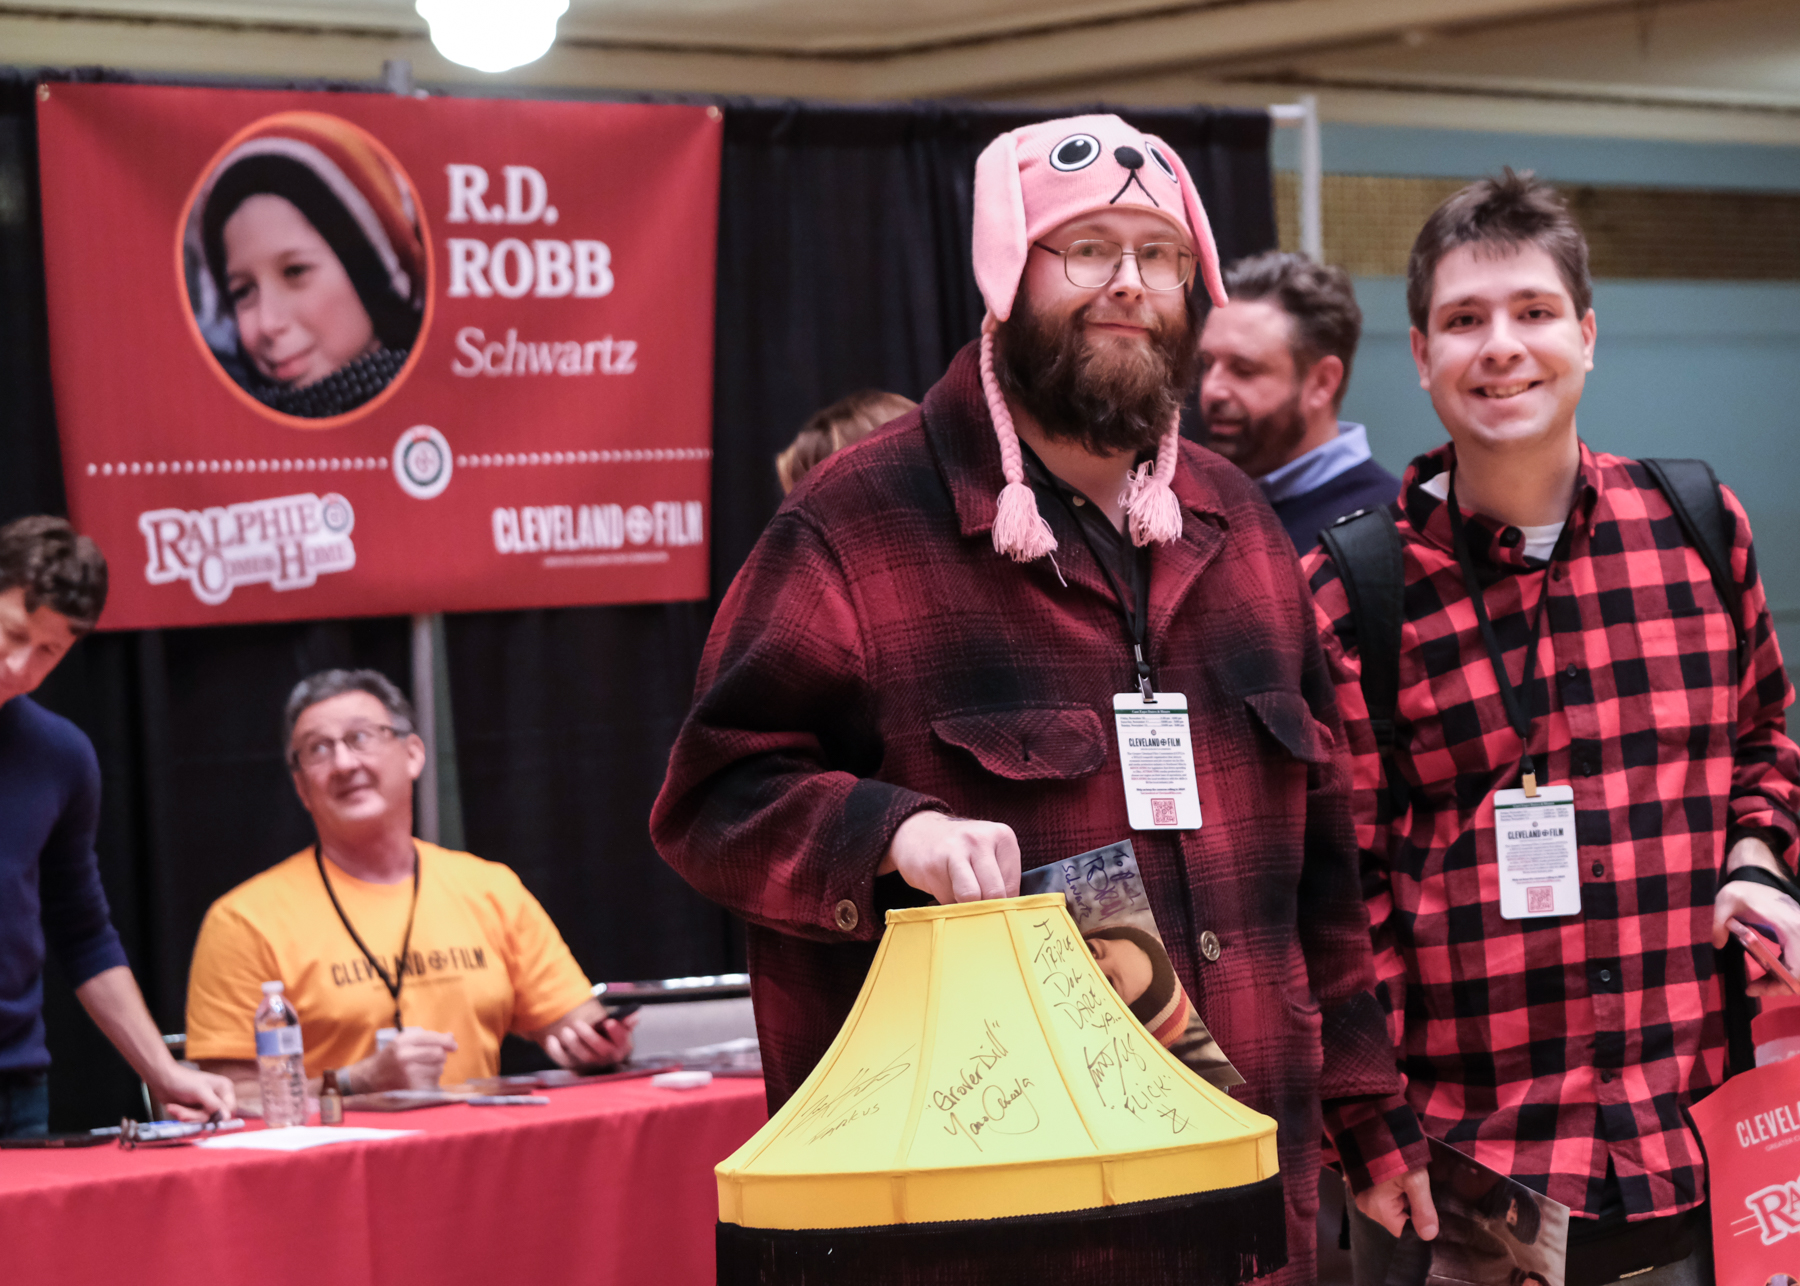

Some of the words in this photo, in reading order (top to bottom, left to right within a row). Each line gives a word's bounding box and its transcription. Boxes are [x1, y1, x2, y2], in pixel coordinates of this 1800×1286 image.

[446, 163, 559, 225] R.D.
[446, 237, 615, 299] ROBB
[451, 326, 638, 378] Schwartz
[147, 502, 320, 574] RALPHIE
[492, 504, 625, 553] CLEVELAND
[1128, 737, 1160, 747] CLEVELAND
[1167, 737, 1181, 747] FILM
[1507, 828, 1541, 840] CLEVELAND
[1549, 827, 1564, 837] FILM
[449, 946, 488, 971] FILM
[1736, 1100, 1800, 1148] CLEVEL
